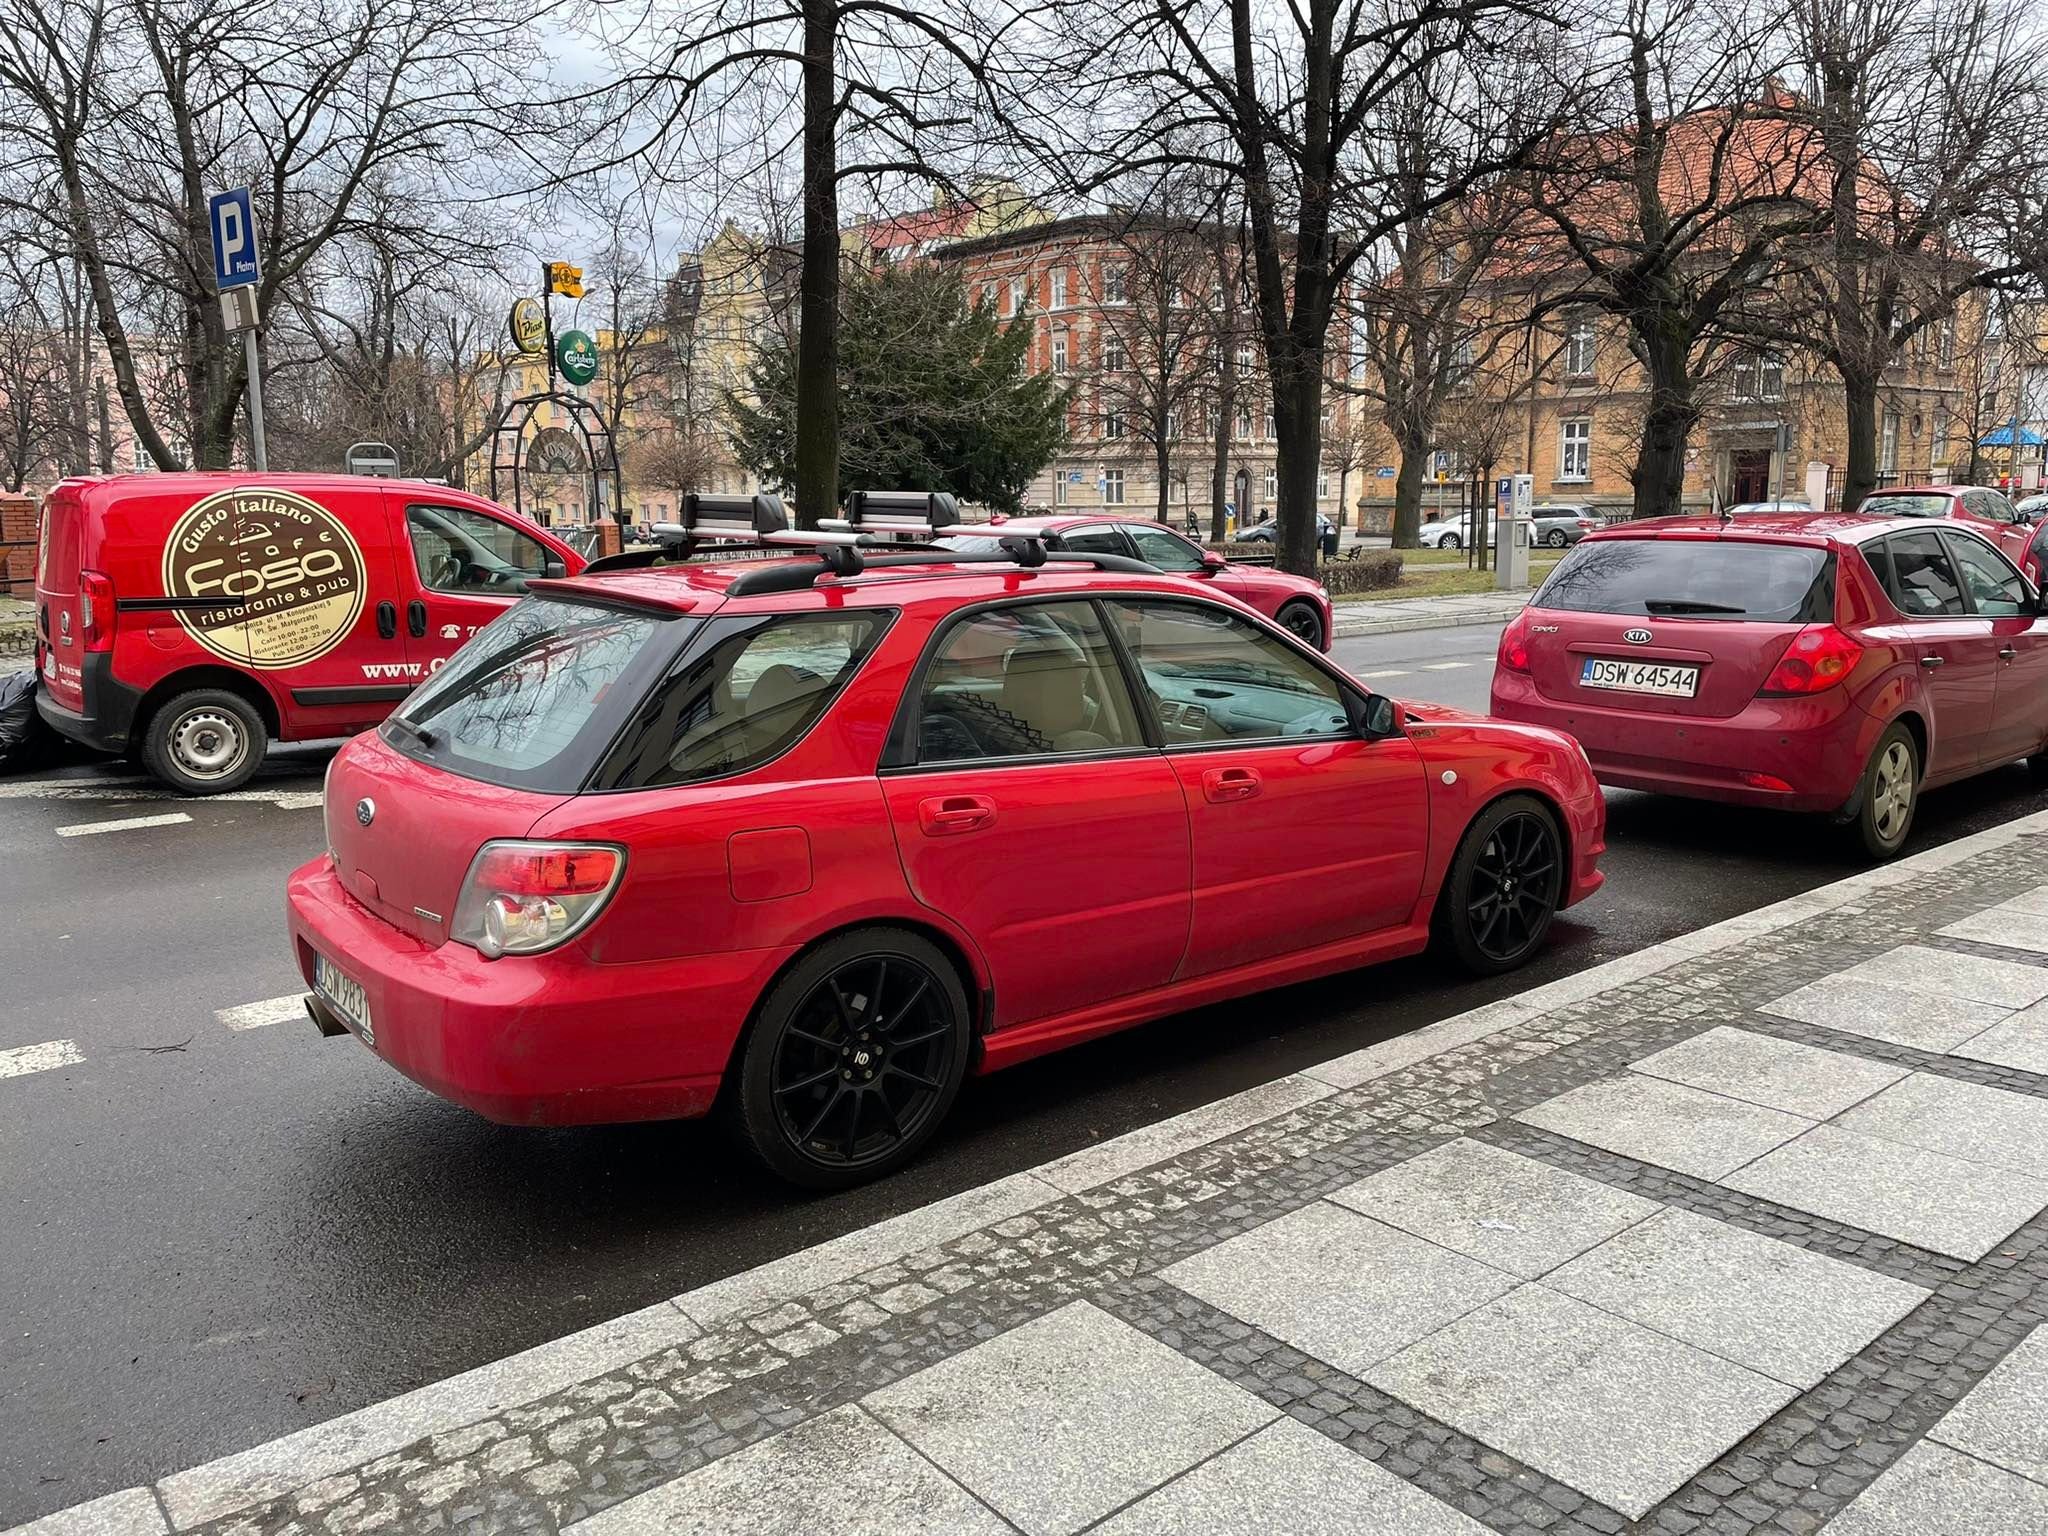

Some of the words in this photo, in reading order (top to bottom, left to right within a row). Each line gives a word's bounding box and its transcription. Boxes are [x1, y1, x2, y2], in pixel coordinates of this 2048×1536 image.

[218, 201, 245, 276] P
[182, 508, 228, 553] Gusto
[232, 498, 313, 525] Italiano
[200, 592, 295, 626] ristorante
[299, 586, 312, 599] &
[316, 576, 350, 596] pub
[1627, 631, 1648, 641] KIA
[1592, 661, 1630, 684] DSW
[1633, 665, 1696, 691] 64544
